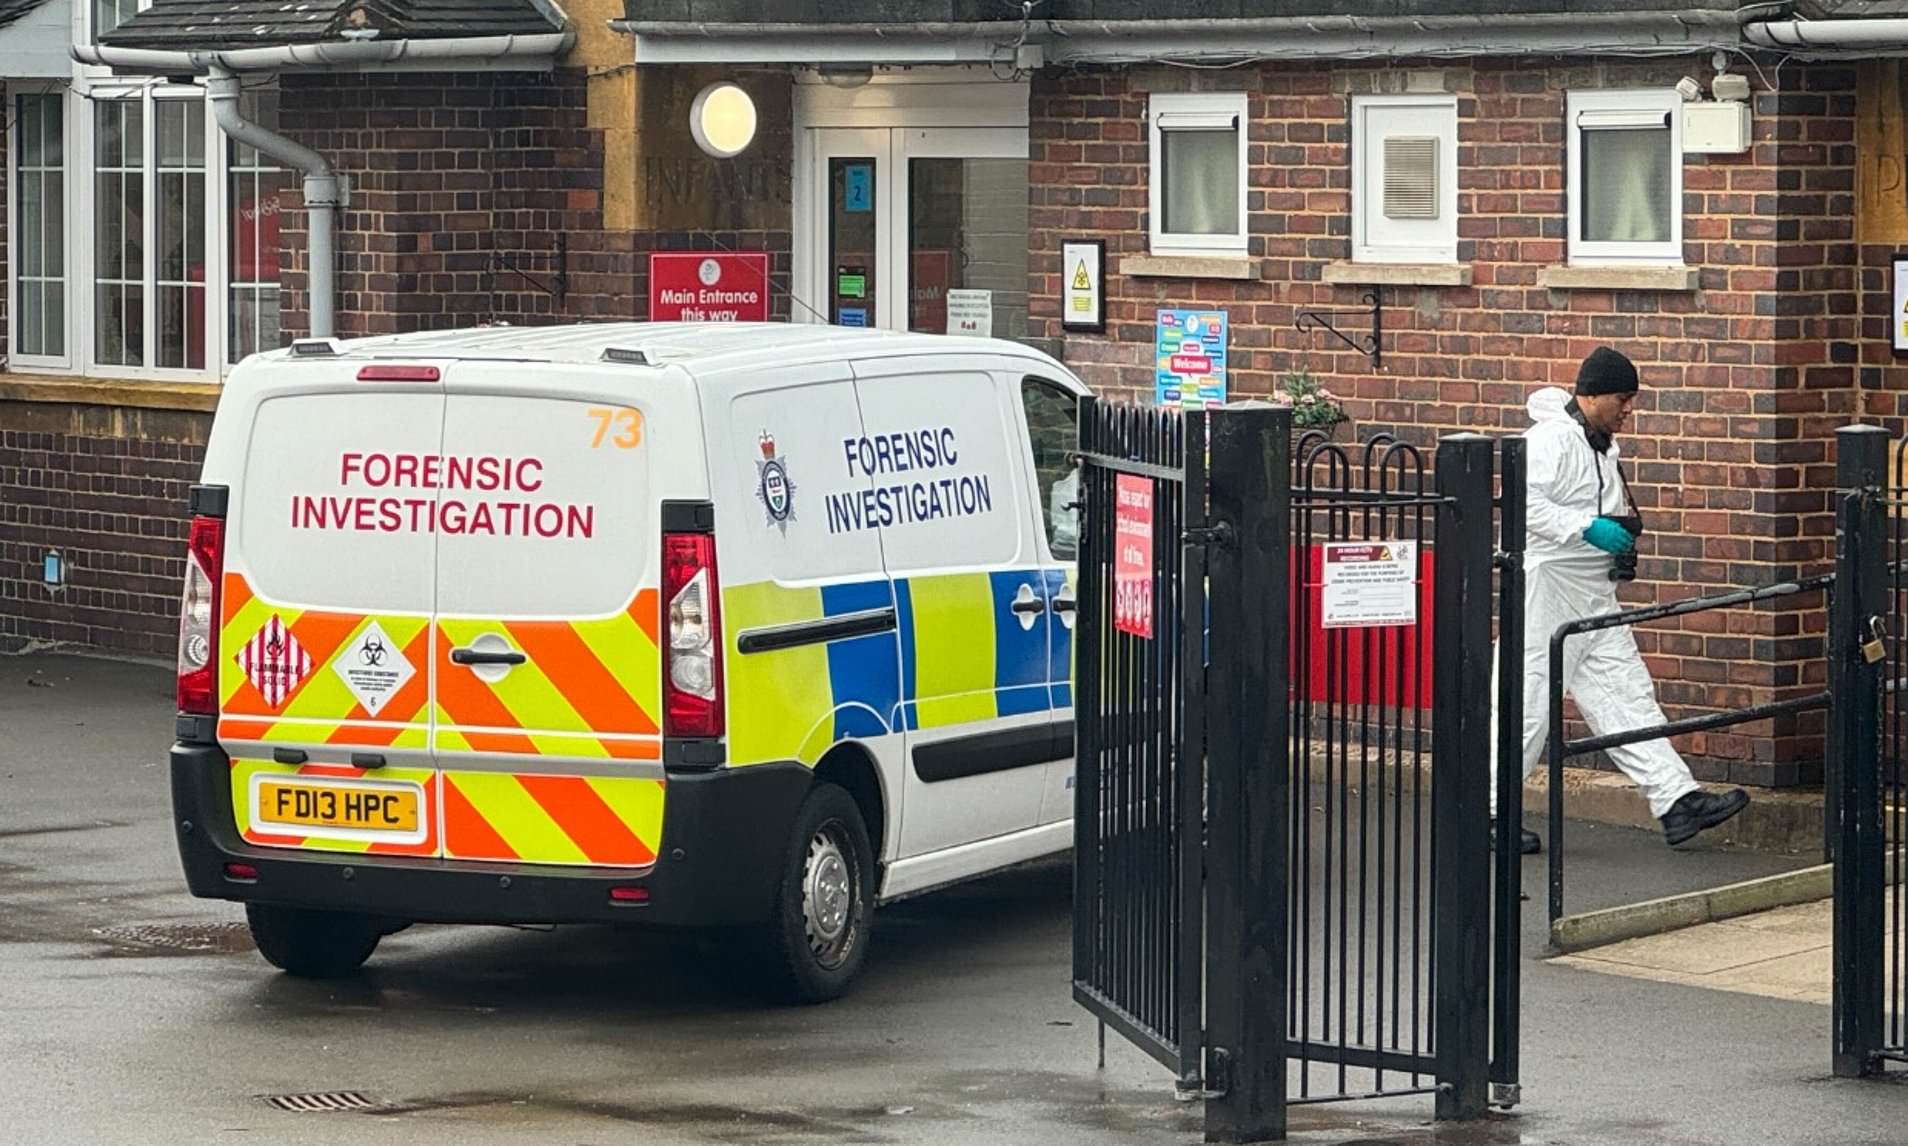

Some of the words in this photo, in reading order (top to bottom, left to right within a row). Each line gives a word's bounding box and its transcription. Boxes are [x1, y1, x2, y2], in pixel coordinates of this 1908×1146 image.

[854, 185, 862, 201] 2
[660, 288, 695, 305] Main
[699, 289, 758, 305] Entrance
[680, 307, 704, 322] this
[708, 310, 738, 322] way
[1173, 357, 1208, 369] Welcome
[586, 406, 642, 449] 73
[843, 426, 958, 478] FORENSIC
[340, 452, 544, 493] FORENSIC
[290, 495, 595, 539] INVESTIGATION
[824, 473, 992, 535] INVESTIGATION
[276, 788, 337, 820] FD13
[345, 793, 400, 824] HPC
